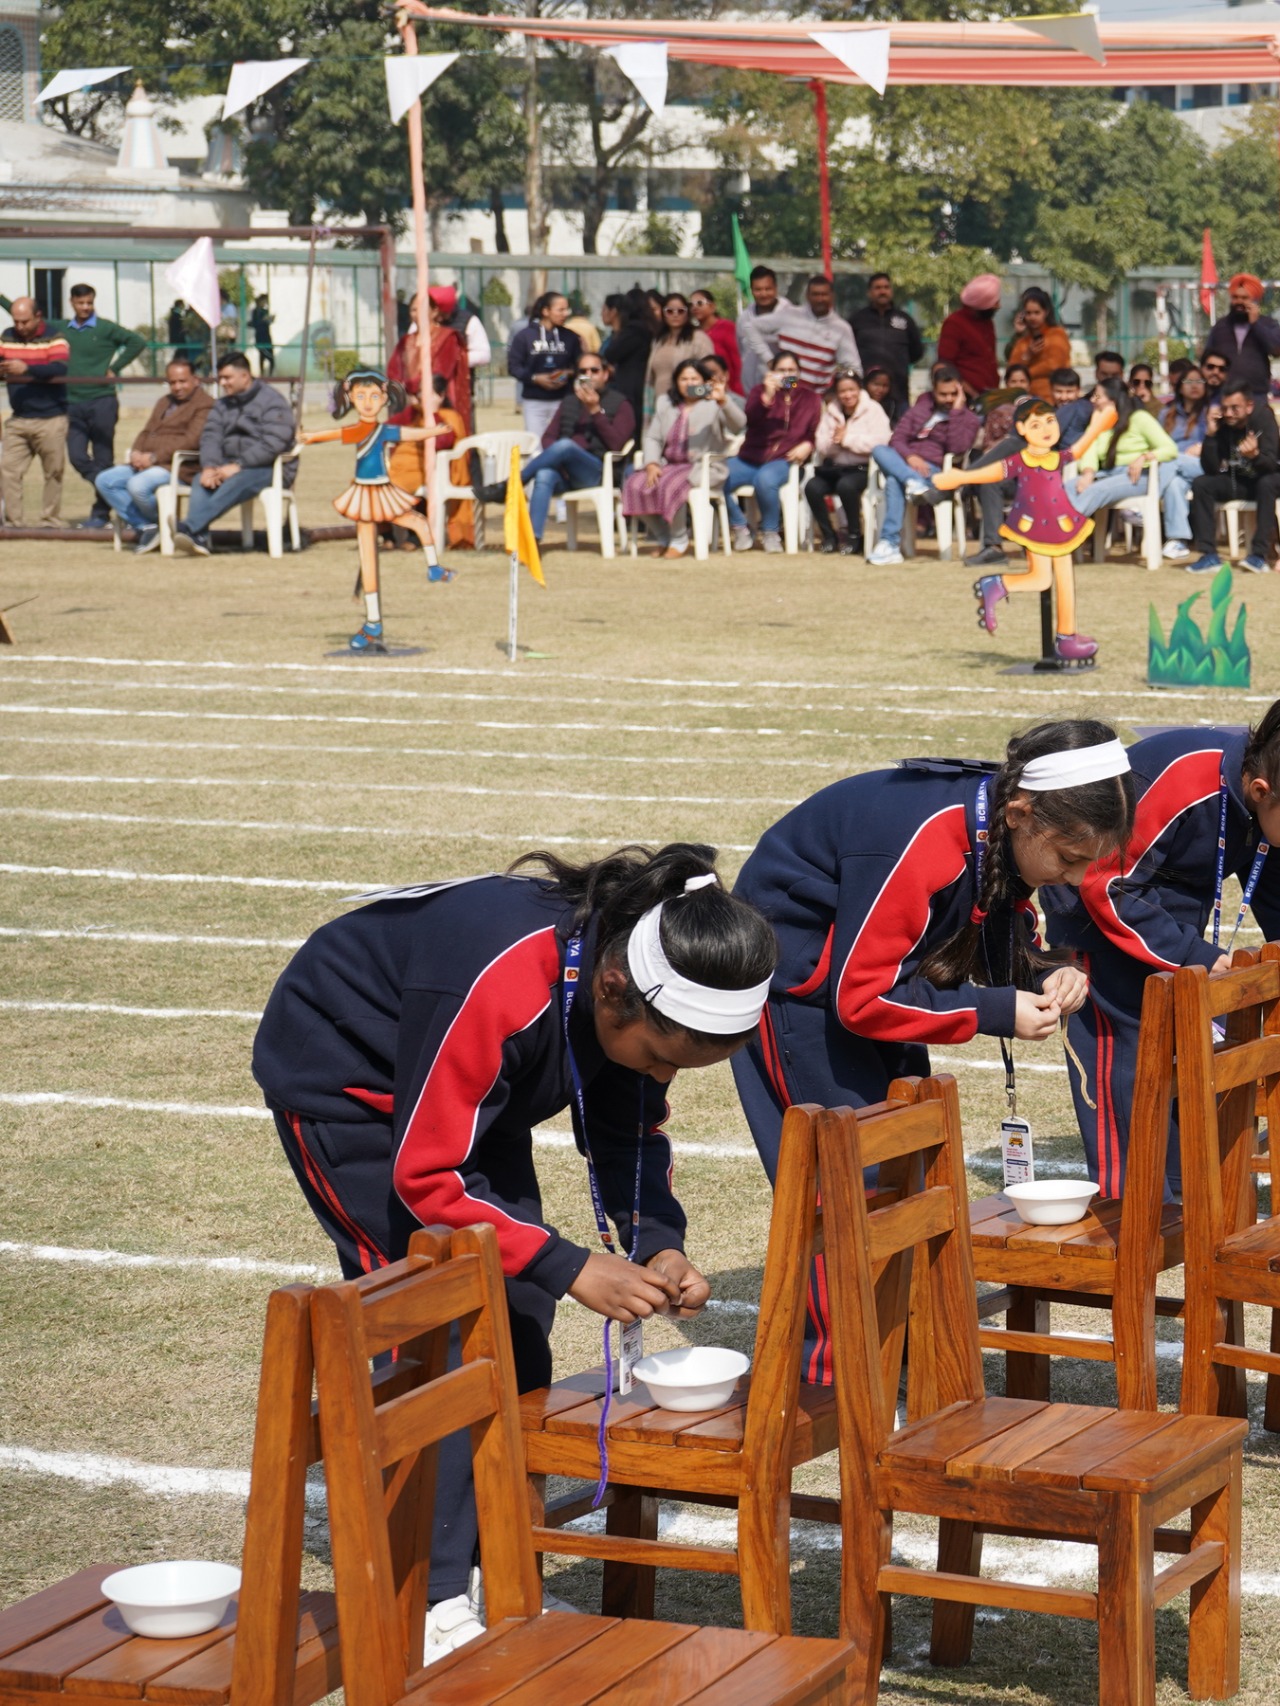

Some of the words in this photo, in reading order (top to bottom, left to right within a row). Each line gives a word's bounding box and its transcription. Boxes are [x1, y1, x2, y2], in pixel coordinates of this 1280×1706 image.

[978, 802, 986, 821] BCM
[1245, 880, 1256, 898] BCM
[1252, 860, 1263, 880] ARYA
[565, 991, 575, 1013] BCM
[594, 1200, 605, 1223] BCM
